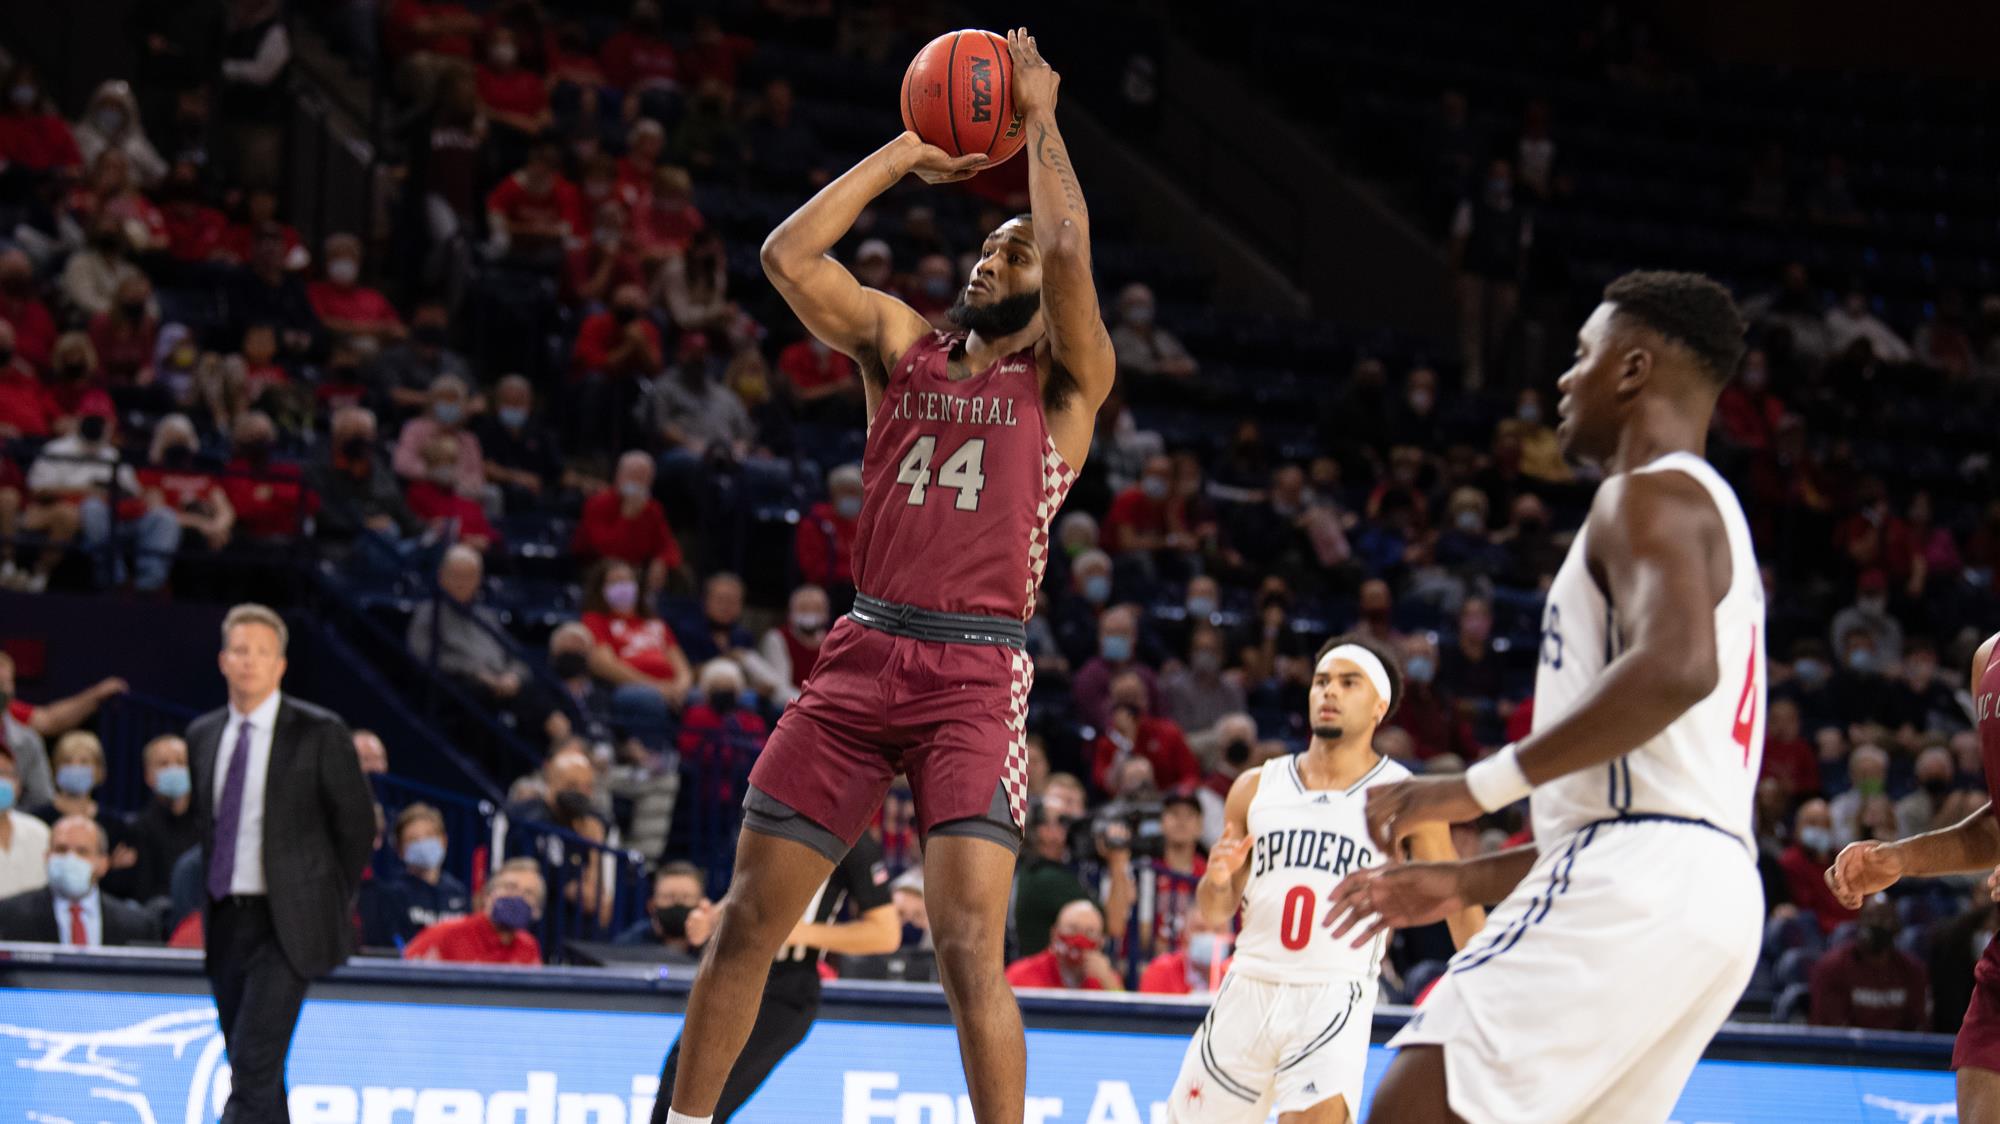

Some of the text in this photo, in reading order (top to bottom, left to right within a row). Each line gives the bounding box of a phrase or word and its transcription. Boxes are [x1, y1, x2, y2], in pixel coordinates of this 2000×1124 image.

[971, 56, 992, 123] NCAA
[918, 391, 1017, 426] CENTRAL
[896, 435, 985, 512] 44
[1280, 884, 1316, 952] 0
